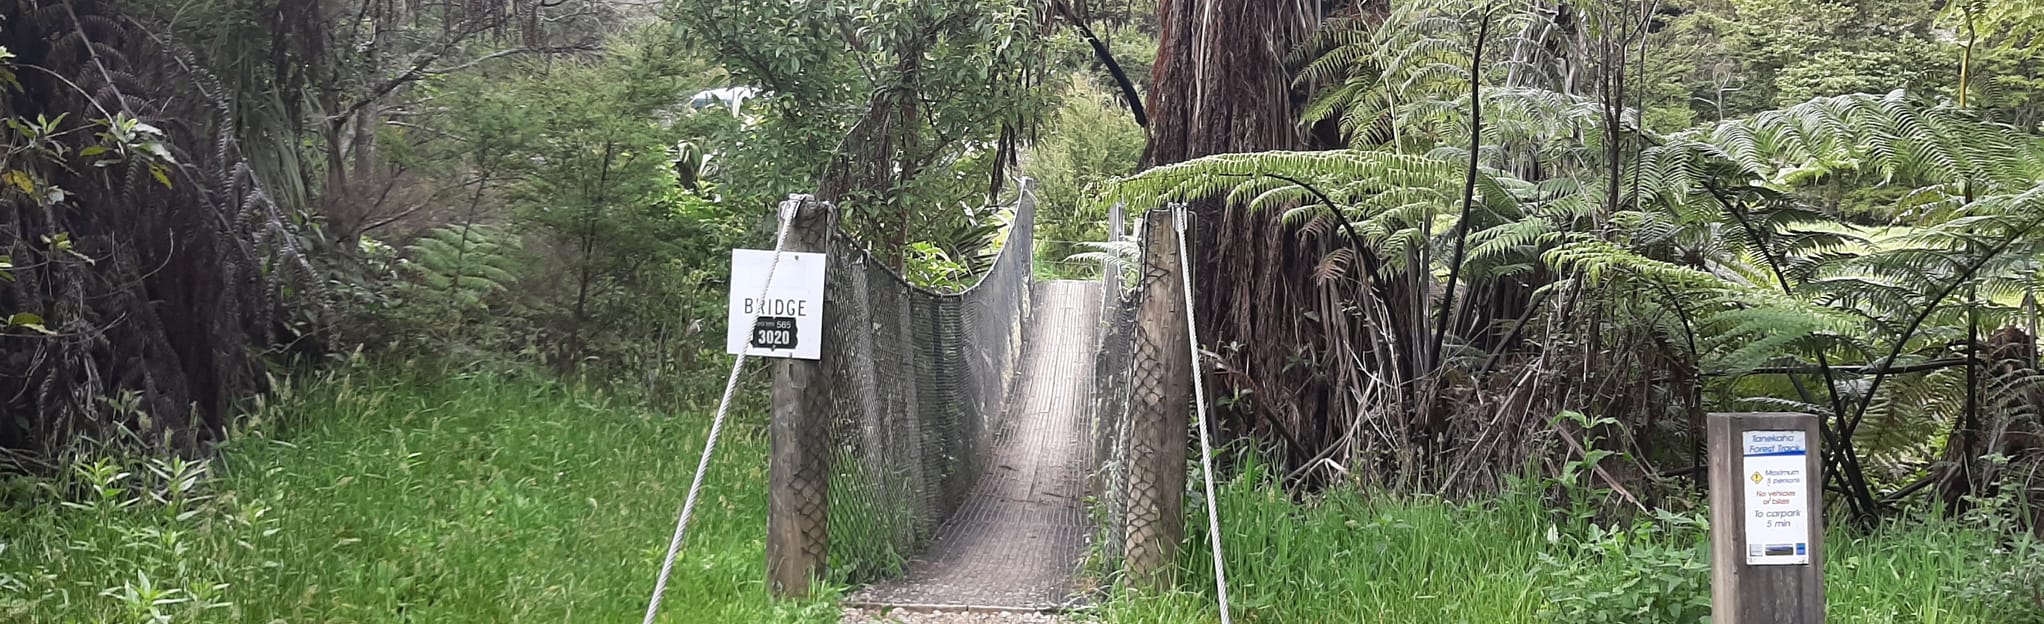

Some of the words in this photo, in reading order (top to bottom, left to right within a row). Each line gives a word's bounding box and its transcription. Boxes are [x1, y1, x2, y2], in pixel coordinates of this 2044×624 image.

[745, 298, 806, 316] BRIDGE
[758, 330, 790, 344] 3020
[1750, 444, 1774, 453] Forest
[1778, 444, 1800, 452] Track
[1755, 510, 1764, 518] To
[1766, 509, 1801, 519] carpark
[1766, 520, 1772, 528] 5
[1774, 520, 1791, 528] min
